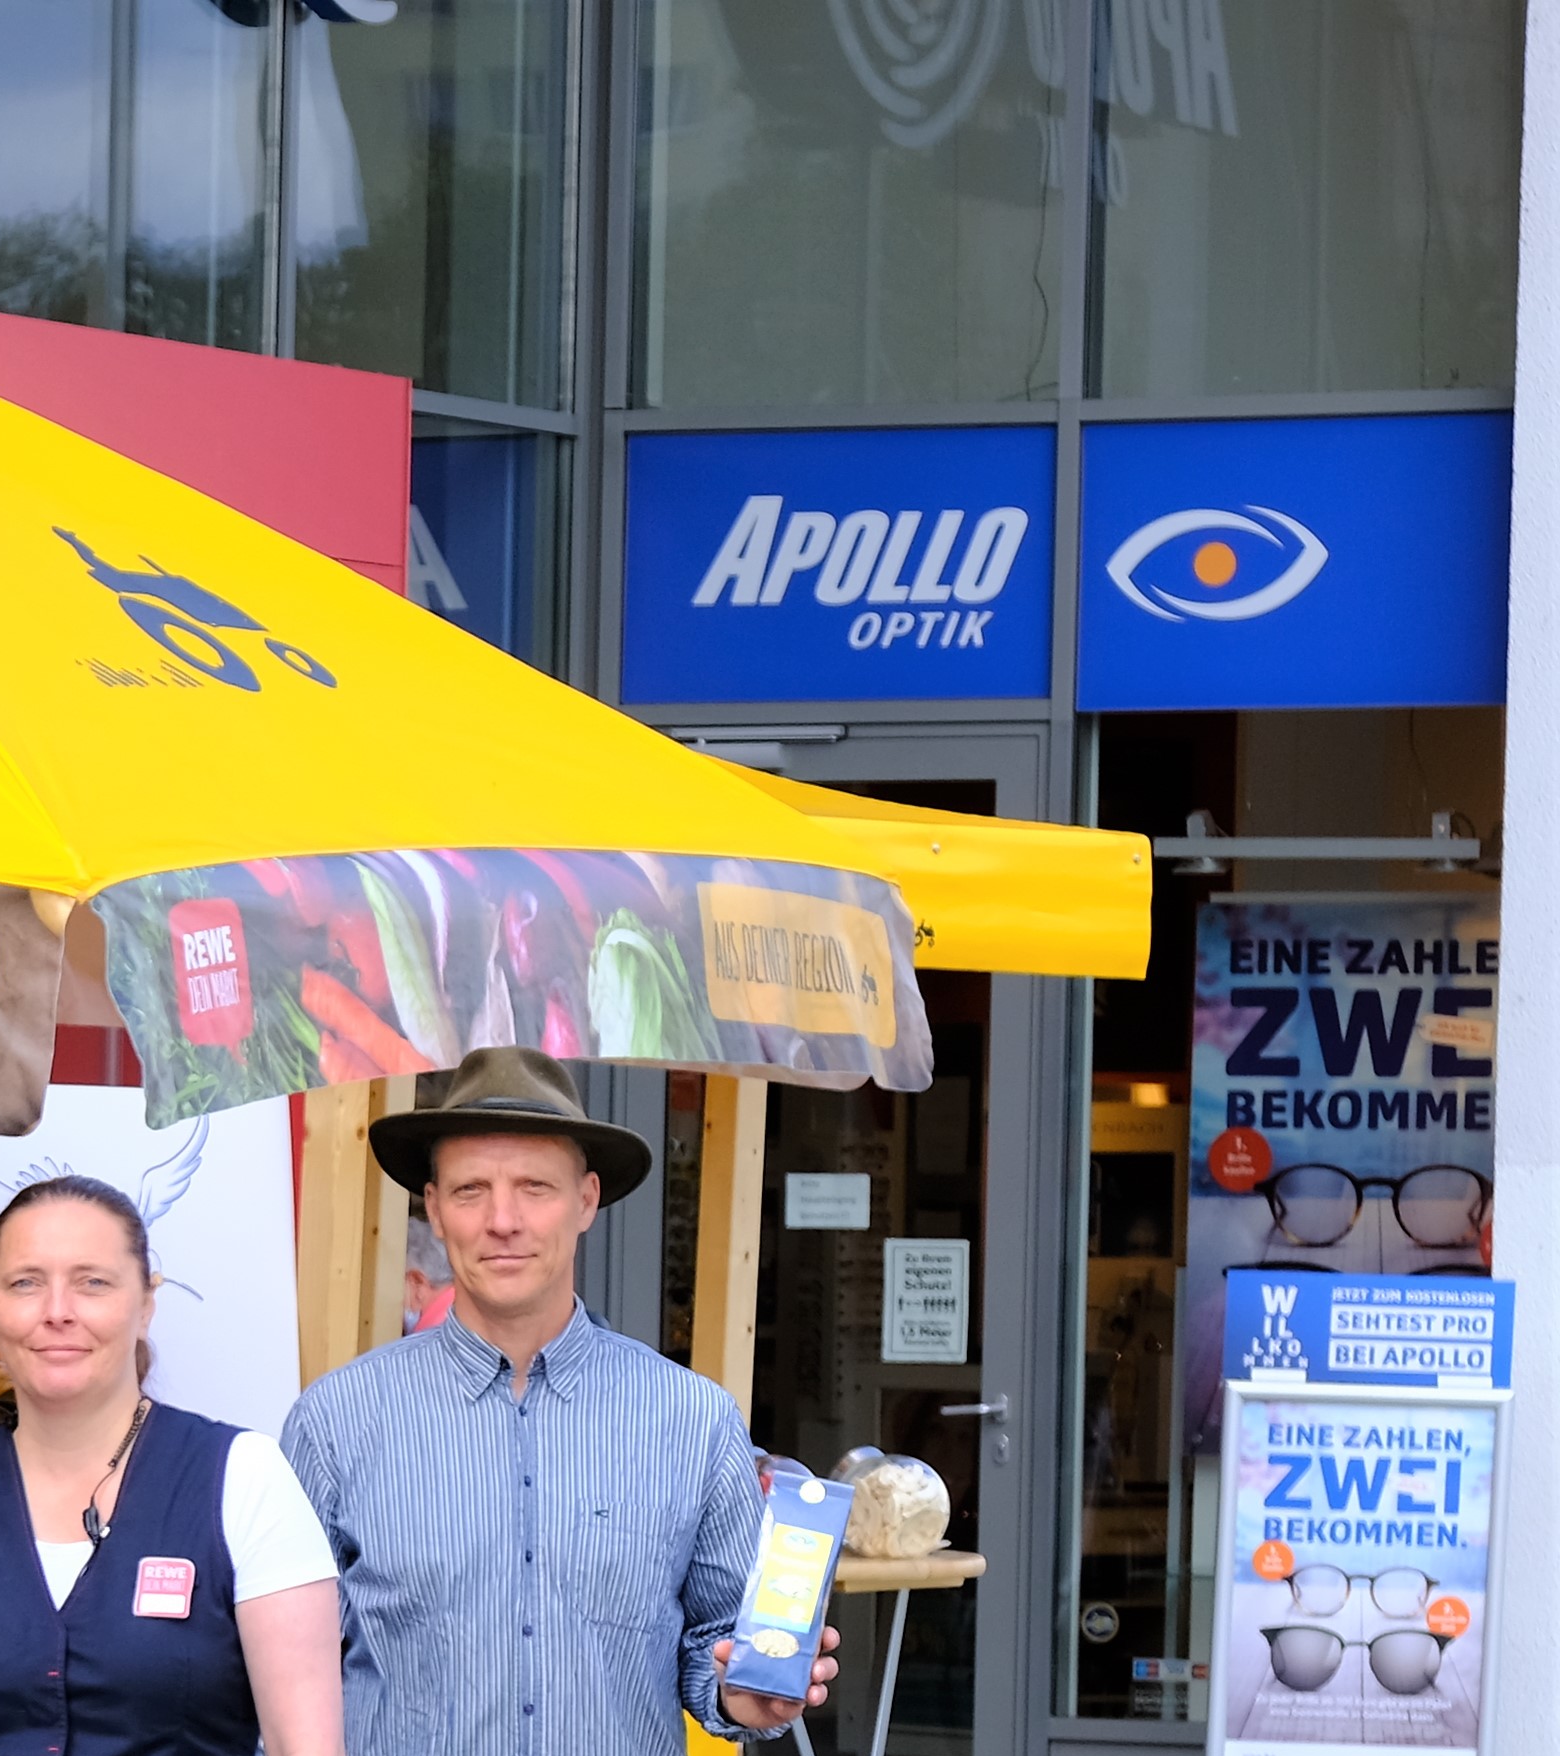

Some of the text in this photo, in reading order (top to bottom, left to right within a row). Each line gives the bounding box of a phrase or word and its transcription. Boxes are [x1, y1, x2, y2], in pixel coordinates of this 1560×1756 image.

[692, 494, 1029, 606] APOLLO
[847, 610, 994, 650] OPTIK
[182, 925, 236, 971] REWE
[714, 921, 856, 994] AUS DEINER REGION
[1229, 939, 1499, 975] EINE ZAHLE
[187, 974, 214, 1015] DEIN
[1225, 987, 1493, 1077] ZWE
[1226, 1090, 1491, 1130] BEKOMME
[1373, 1287, 1401, 1304] ZUM
[1337, 1311, 1488, 1334] SEHTEST PRO
[1335, 1344, 1485, 1369] BEI APOLLO
[1269, 1423, 1471, 1456] EINE ZAHLEN,
[1264, 1453, 1462, 1514] ZWEI
[1264, 1517, 1467, 1548] BEKOMMEN.
[144, 1565, 188, 1580] REWE
